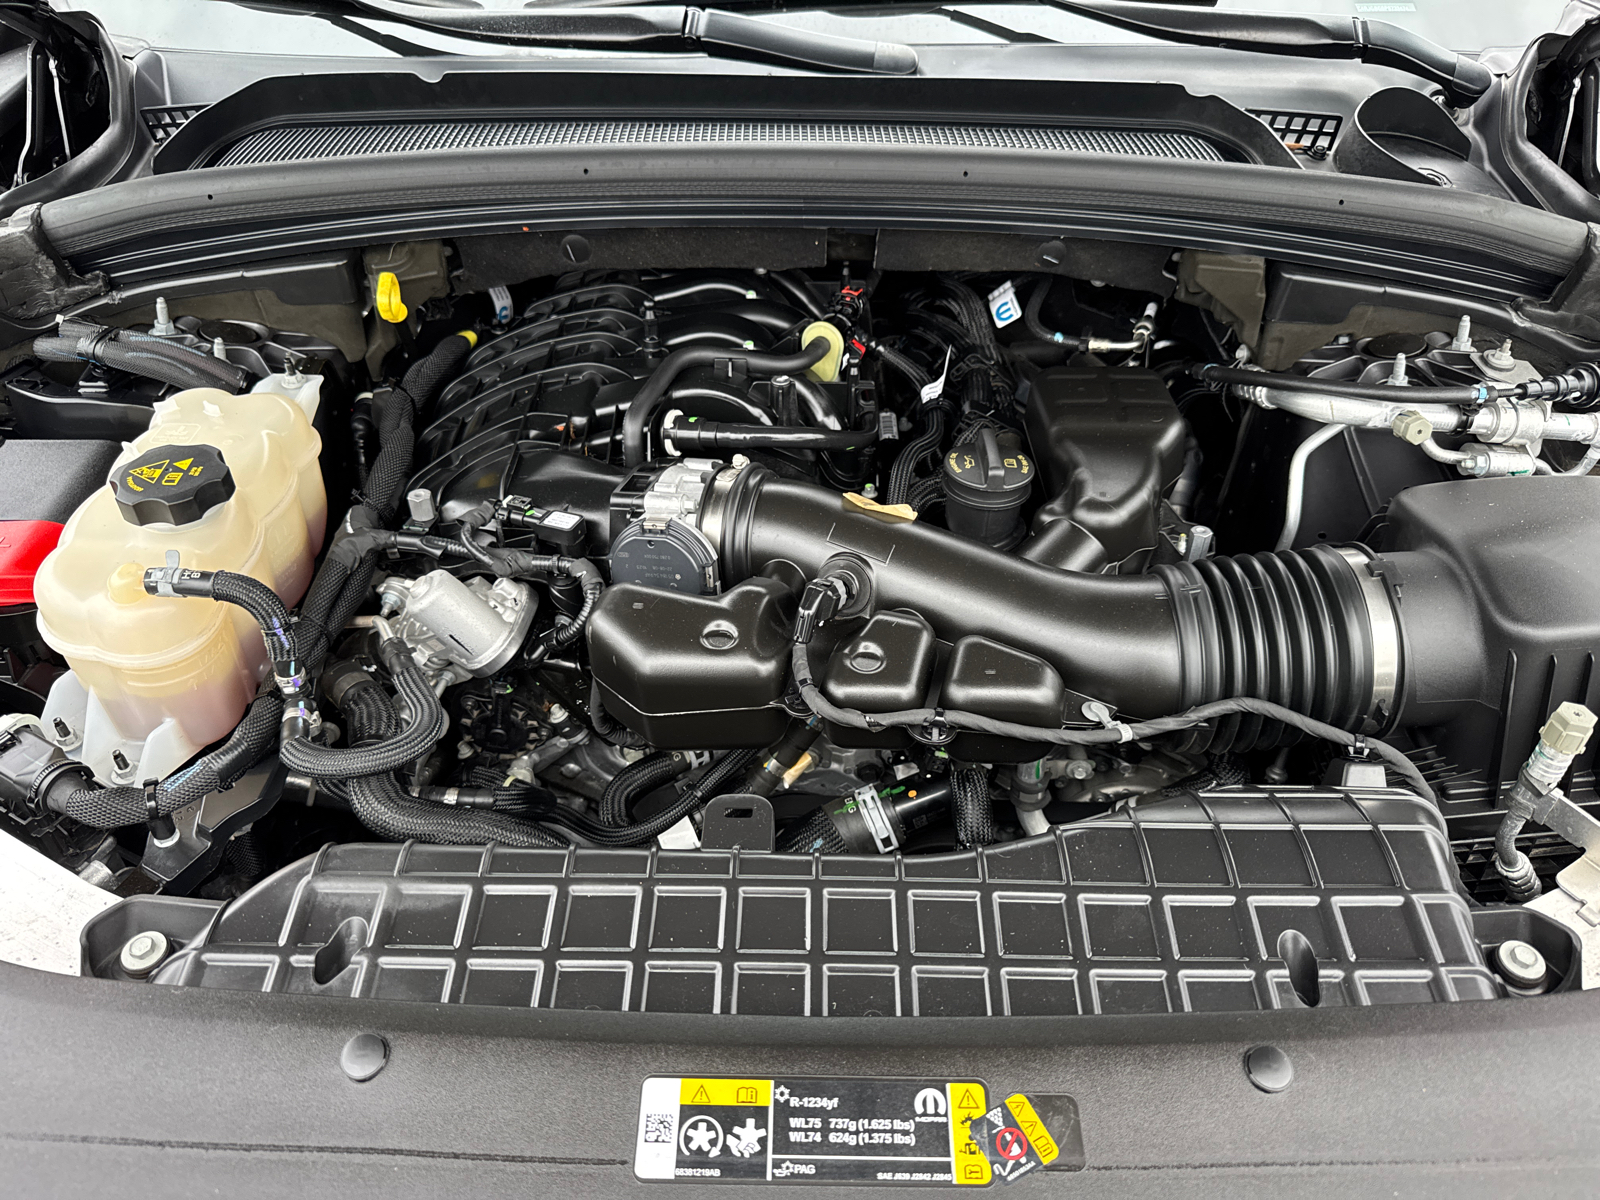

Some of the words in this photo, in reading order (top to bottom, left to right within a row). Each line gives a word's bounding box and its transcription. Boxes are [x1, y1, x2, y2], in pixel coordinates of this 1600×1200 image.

[789, 1097, 839, 1110] R-1234yf
[789, 1118, 822, 1129] WL75
[828, 1118, 856, 1131] 737g
[858, 1119, 892, 1131] (1.625
[893, 1119, 916, 1132] lbs)
[789, 1132, 822, 1142] WL74
[828, 1132, 856, 1145] 624g
[858, 1132, 892, 1146] (1.375
[893, 1133, 916, 1146] lbs)
[794, 1164, 816, 1174] PAG
